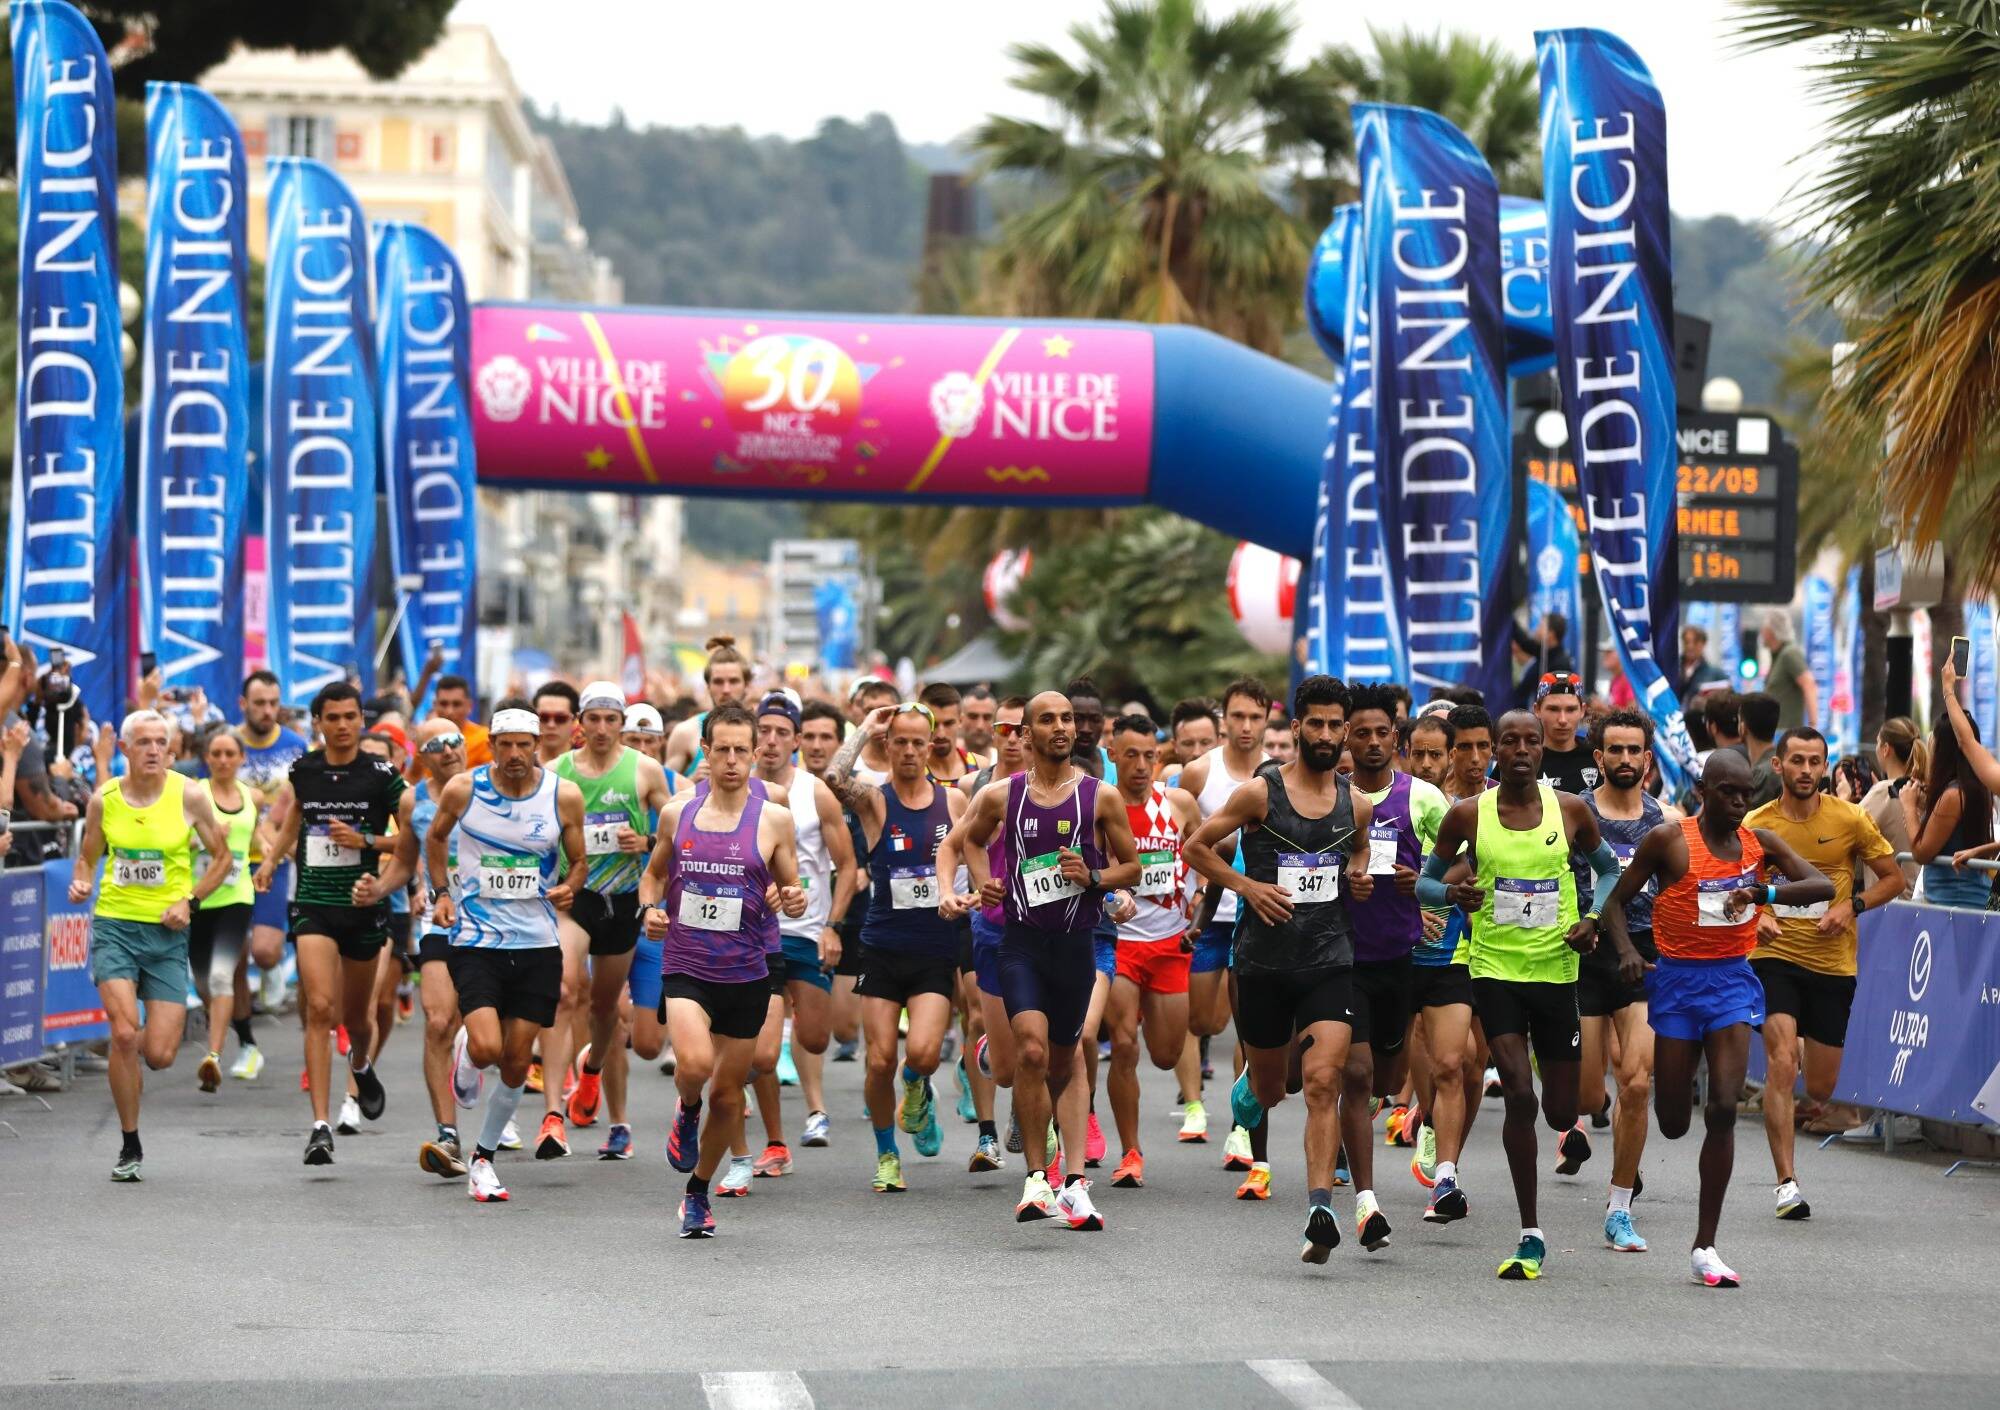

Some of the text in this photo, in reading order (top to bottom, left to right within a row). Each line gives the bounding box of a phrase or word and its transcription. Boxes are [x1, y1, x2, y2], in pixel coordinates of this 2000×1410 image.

[1570, 111, 1639, 327] NICE
[1392, 185, 1474, 375] NICE
[22, 53, 98, 678] VILLE DE NICE
[742, 335, 838, 412] 30
[990, 371, 1119, 402] VILLE DE
[161, 136, 234, 681] VILLE DE NICE
[538, 383, 667, 429] NICE
[992, 396, 1120, 442] NICE
[1578, 349, 1643, 468] DE
[287, 204, 354, 698] VILLE DE NICE
[1400, 395, 1476, 499] DE
[405, 261, 464, 666] ILLE DE NICE
[1677, 465, 1759, 494] 22/05
[594, 831, 609, 845] 14
[1024, 818, 1038, 831] APA
[325, 843, 339, 857] 13
[1133, 836, 1175, 852] ONACO
[489, 875, 532, 889] 10 077
[680, 860, 745, 876] TOULOUSE
[1145, 870, 1167, 886] 040
[913, 884, 929, 899] 99
[1033, 876, 1050, 894] 10
[1298, 875, 1324, 892] 347
[700, 904, 718, 920] 12
[1522, 901, 1532, 917] 4
[1889, 1009, 1928, 1049] ULTRA
